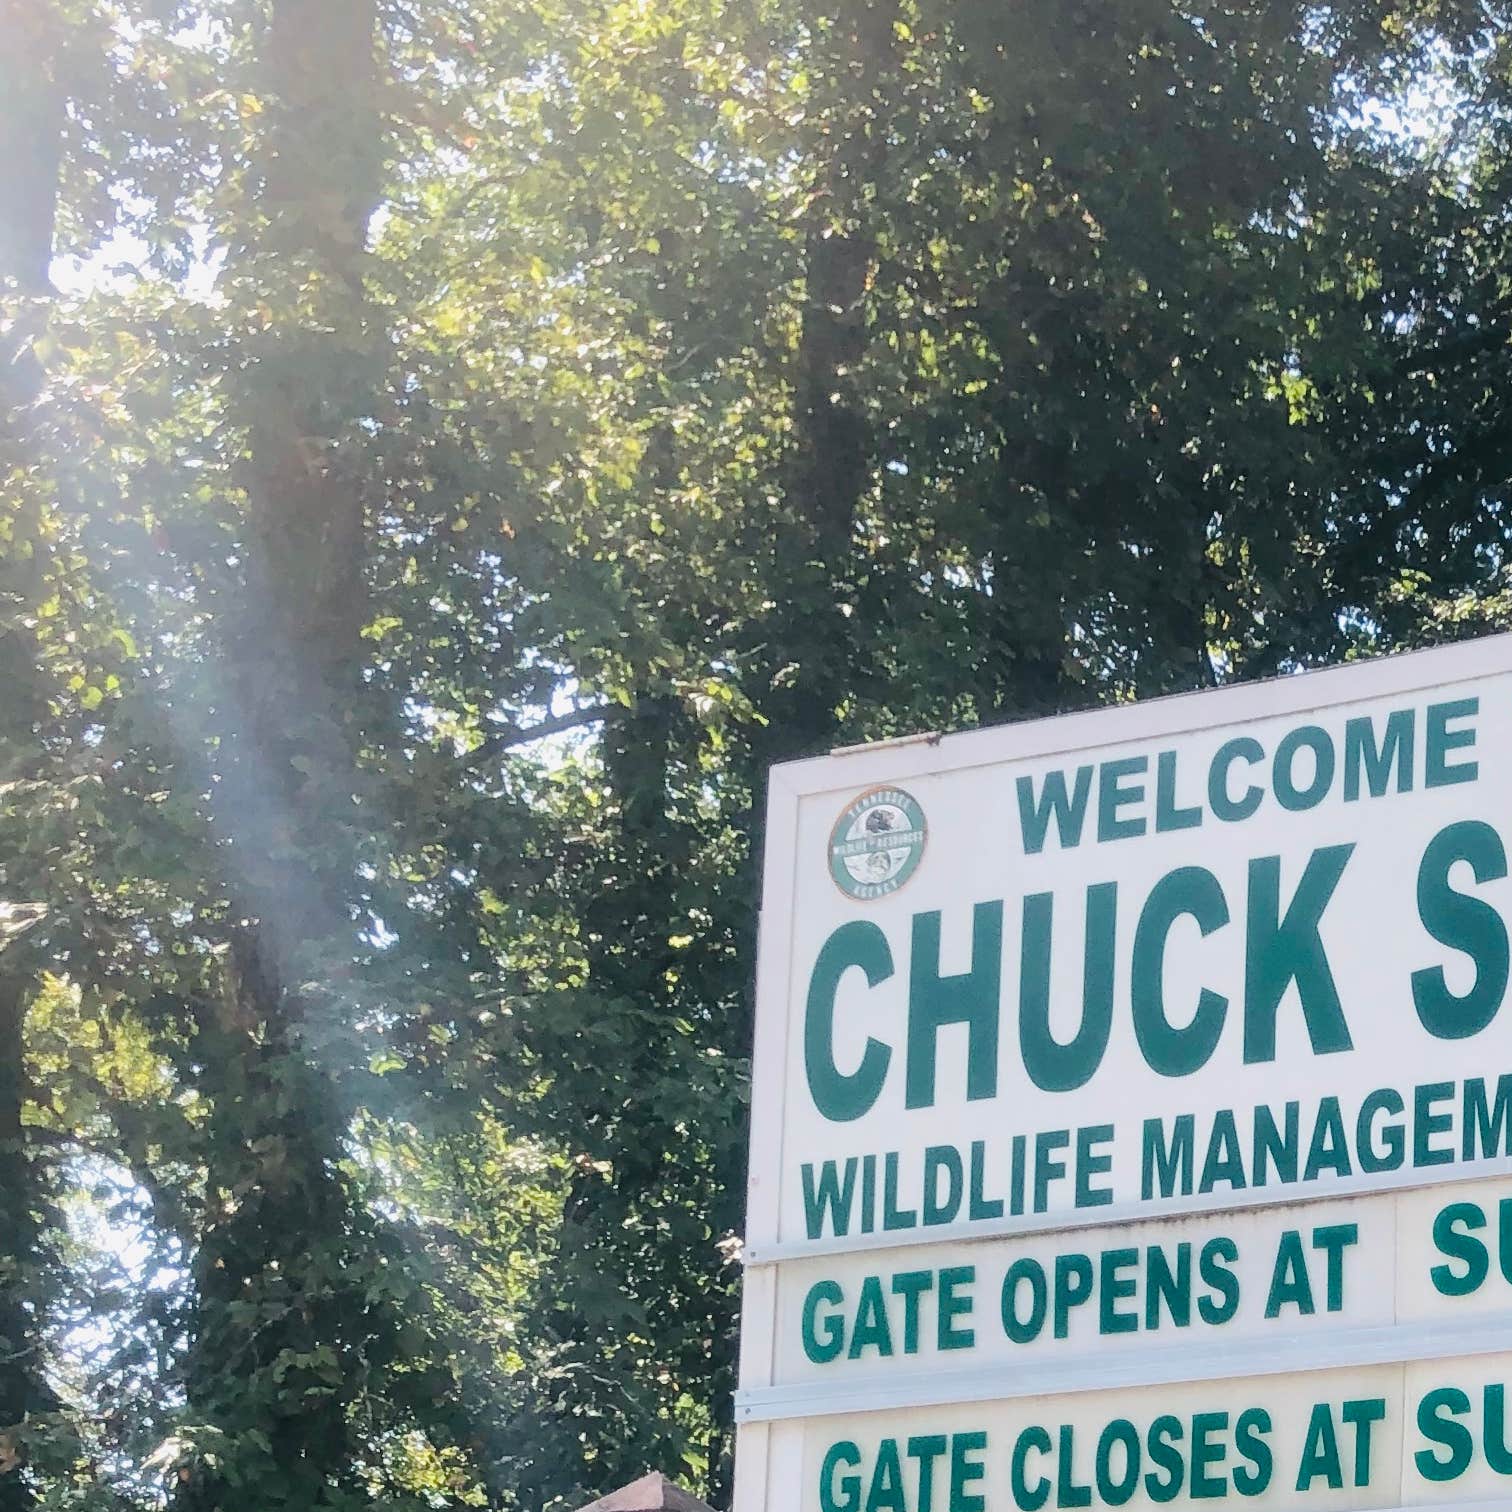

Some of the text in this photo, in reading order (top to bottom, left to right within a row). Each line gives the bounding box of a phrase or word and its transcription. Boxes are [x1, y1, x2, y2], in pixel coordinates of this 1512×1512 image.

[1016, 697, 1480, 853] WELCOME
[803, 843, 1355, 1123] CHUCK
[801, 1124, 1115, 1240] WILDLIFE
[800, 1264, 977, 1365] GATE
[999, 1236, 1241, 1345] OPENS
[1263, 1222, 1359, 1319] AT
[1010, 1406, 1274, 1512] CLOSES
[1294, 1397, 1387, 1493] AT
